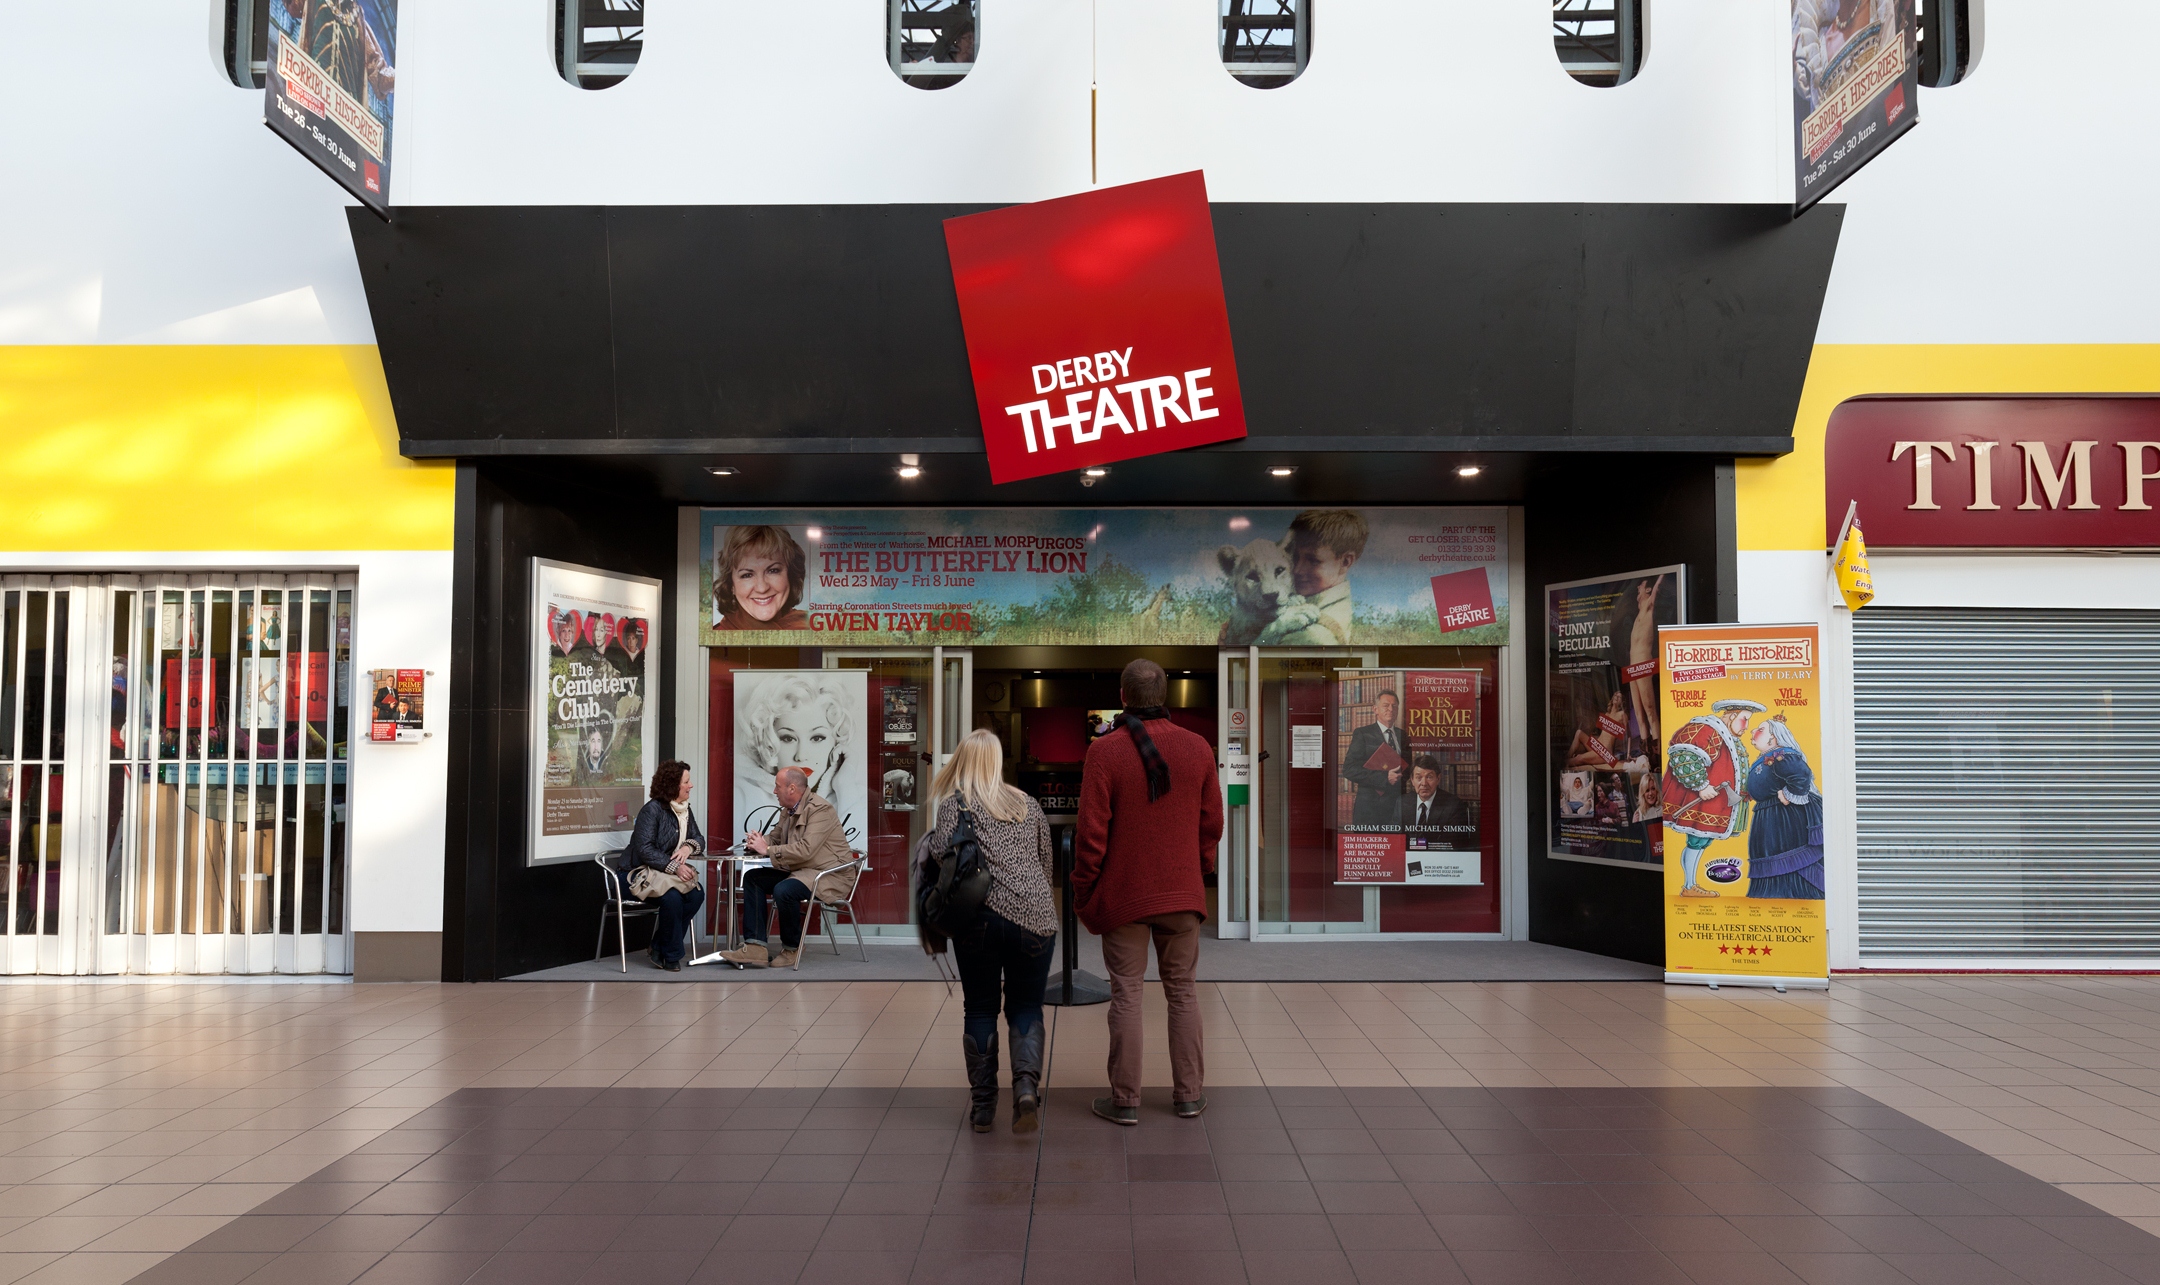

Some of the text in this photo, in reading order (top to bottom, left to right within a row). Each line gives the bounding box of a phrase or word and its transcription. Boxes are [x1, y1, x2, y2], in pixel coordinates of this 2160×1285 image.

[285, 49, 378, 148] HORRIBLE HISTORIES
[1808, 49, 1898, 144] HORRIBLE HISTORIES
[276, 94, 357, 172] Tue 26 Sat 30 June
[1803, 121, 1877, 187] Tue 26 Sat 30 June
[1031, 346, 1133, 395] DERBY
[1005, 366, 1220, 454] THEATRE
[1891, 440, 2160, 510] TIMP
[1442, 526, 1495, 534] PART OF THE
[840, 541, 852, 549] the
[854, 541, 876, 549] Writer
[878, 541, 886, 549] of
[889, 541, 927, 550] Warhorse,
[928, 536, 991, 548] MICHAEL
[1438, 545, 1495, 553] 01332 59 39 39
[819, 551, 1087, 574] THE BUTTERFLY LION
[1419, 554, 1495, 563] derbytheatre.co.uk
[819, 574, 849, 588] Wed
[852, 575, 867, 588] 23
[870, 575, 899, 590] May
[912, 574, 930, 588] Fri
[933, 575, 941, 588] 8
[944, 574, 975, 588] June
[1855, 580, 1873, 590] Eng
[809, 602, 972, 612] Starring Coronation Streets much loved
[1449, 603, 1471, 614] DERBY
[809, 612, 972, 632] GWEN TAYLOR
[1444, 608, 1490, 627] THEATRE
[1558, 621, 1595, 637] FUNNY
[1558, 635, 1611, 652] PECULIAR
[1674, 645, 1803, 663] HORRIBLE HISTORIES
[570, 662, 593, 677] The
[1695, 666, 1719, 675] SHOWS
[1702, 671, 1724, 679] STAGE
[1742, 671, 1774, 680] TERRY
[1776, 670, 1813, 680] DEARY
[552, 674, 638, 697] Cemetery
[1670, 689, 1707, 700] TERRIBLE
[1778, 688, 1802, 699] VILE
[1427, 697, 1454, 709] YES,
[1674, 700, 1704, 708] TUDORS
[1773, 698, 1809, 706] VICTORIANS
[558, 697, 600, 720] Club
[1409, 709, 1473, 725] PRIME
[1408, 726, 1473, 738] MINISTER
[892, 757, 915, 765] EQUUS
[1039, 797, 1080, 808] GREAT
[1344, 824, 1476, 833] GRAHAM SEED MICHAEL SIMKINS
[1712, 924, 1746, 932] LATEST
[1748, 925, 1802, 934] SENSATION
[1679, 932, 1693, 940] ON
[1695, 932, 1714, 940] THE
[1716, 933, 1774, 942] THEATRICAL
